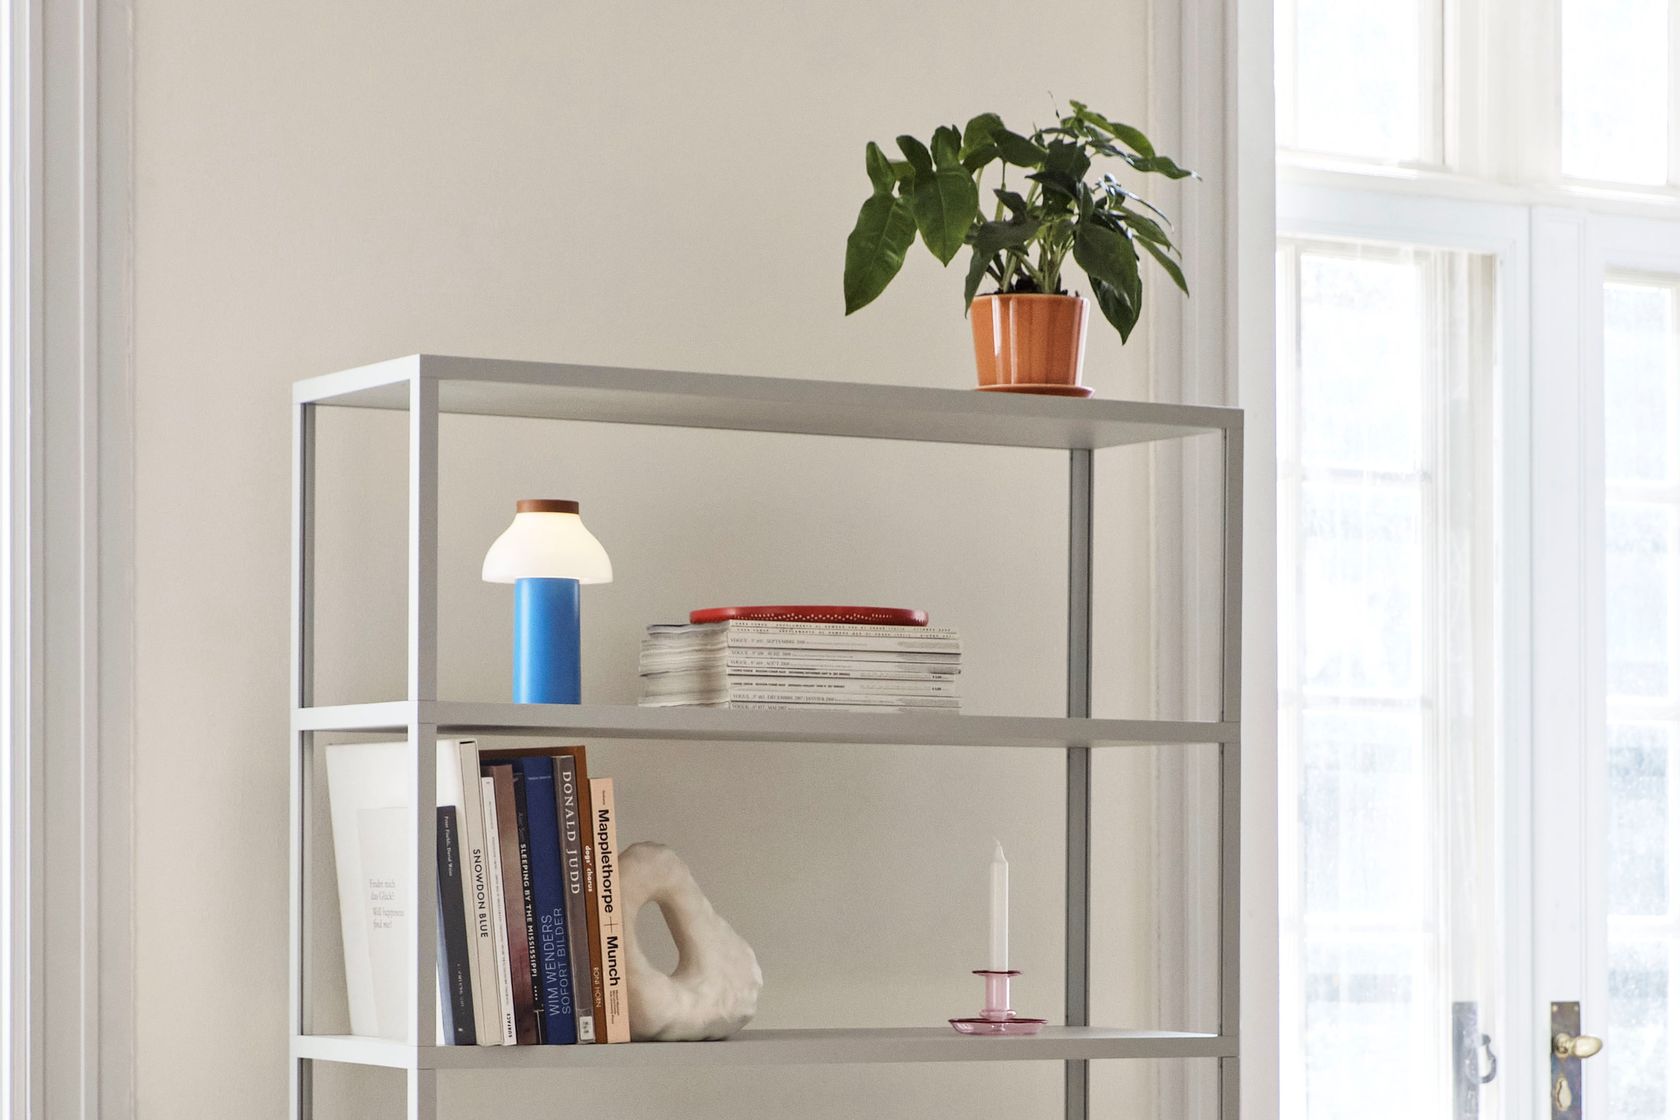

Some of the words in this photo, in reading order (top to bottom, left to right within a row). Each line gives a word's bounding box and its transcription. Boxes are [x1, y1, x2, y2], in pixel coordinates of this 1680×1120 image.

[562, 771, 576, 842] DONALD
[472, 848, 486, 910] SNOWDON
[520, 843, 530, 887] SLEEPING
[566, 849, 580, 894] JUDD
[523, 889, 532, 902] BY
[525, 904, 533, 922] THE
[597, 808, 615, 914] Mapplethorpe
[606, 935, 621, 987] Munch
[478, 913, 489, 938] BLUE
[540, 914, 557, 984] WENDERS
[553, 907, 567, 957] BILDER
[527, 925, 538, 977] MISSISSIPPI
[546, 987, 560, 1017] WIM
[557, 961, 572, 1015] SOFORT
